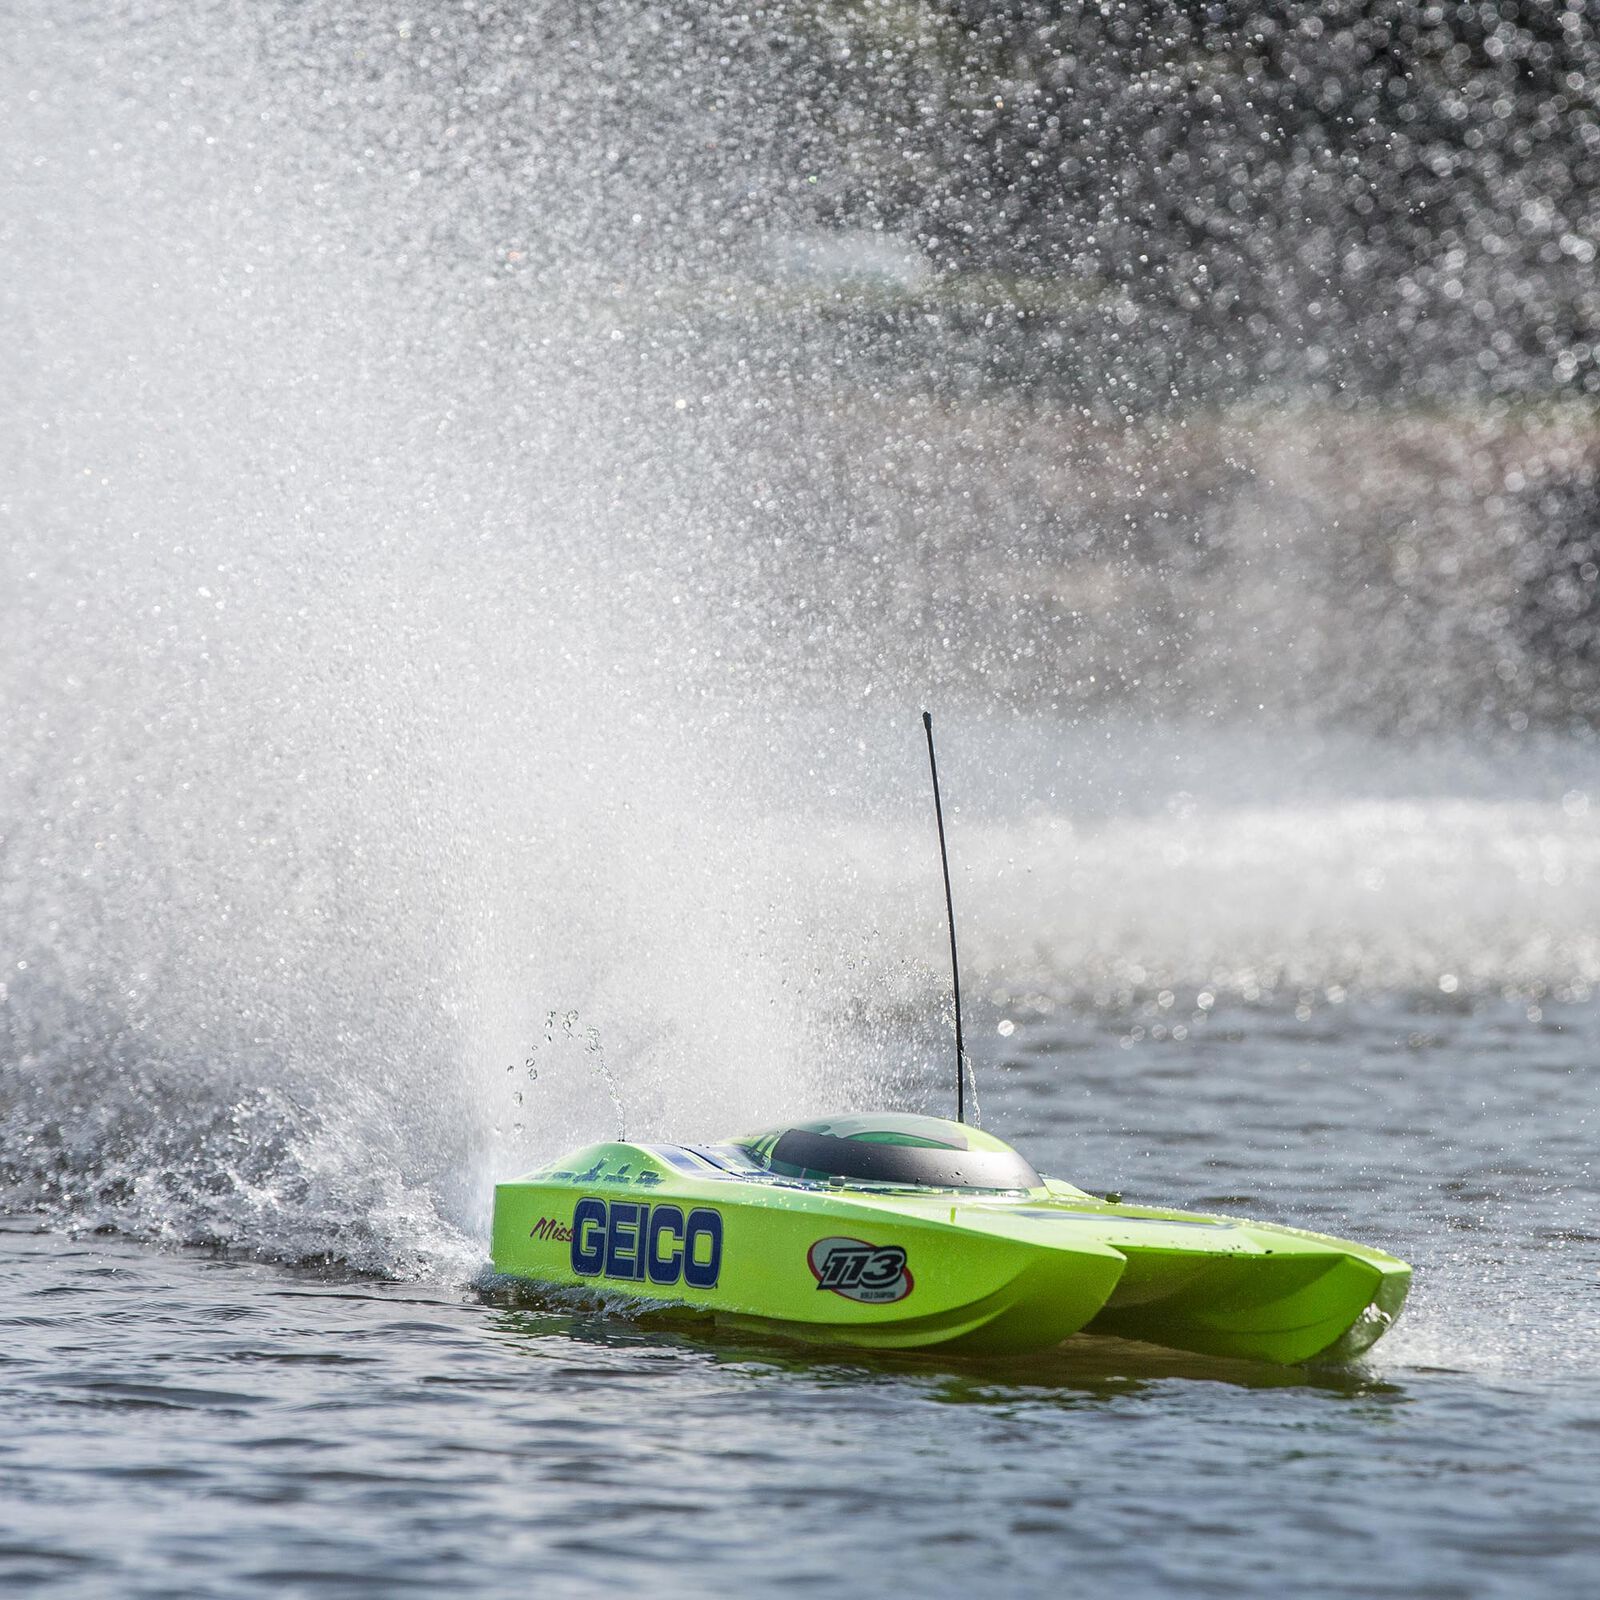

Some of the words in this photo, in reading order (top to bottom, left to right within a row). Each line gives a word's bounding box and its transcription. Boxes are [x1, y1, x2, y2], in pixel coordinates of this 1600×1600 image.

[529, 1216, 574, 1241] Miss
[570, 1196, 723, 1289] GEICO
[818, 1246, 907, 1289] 113
